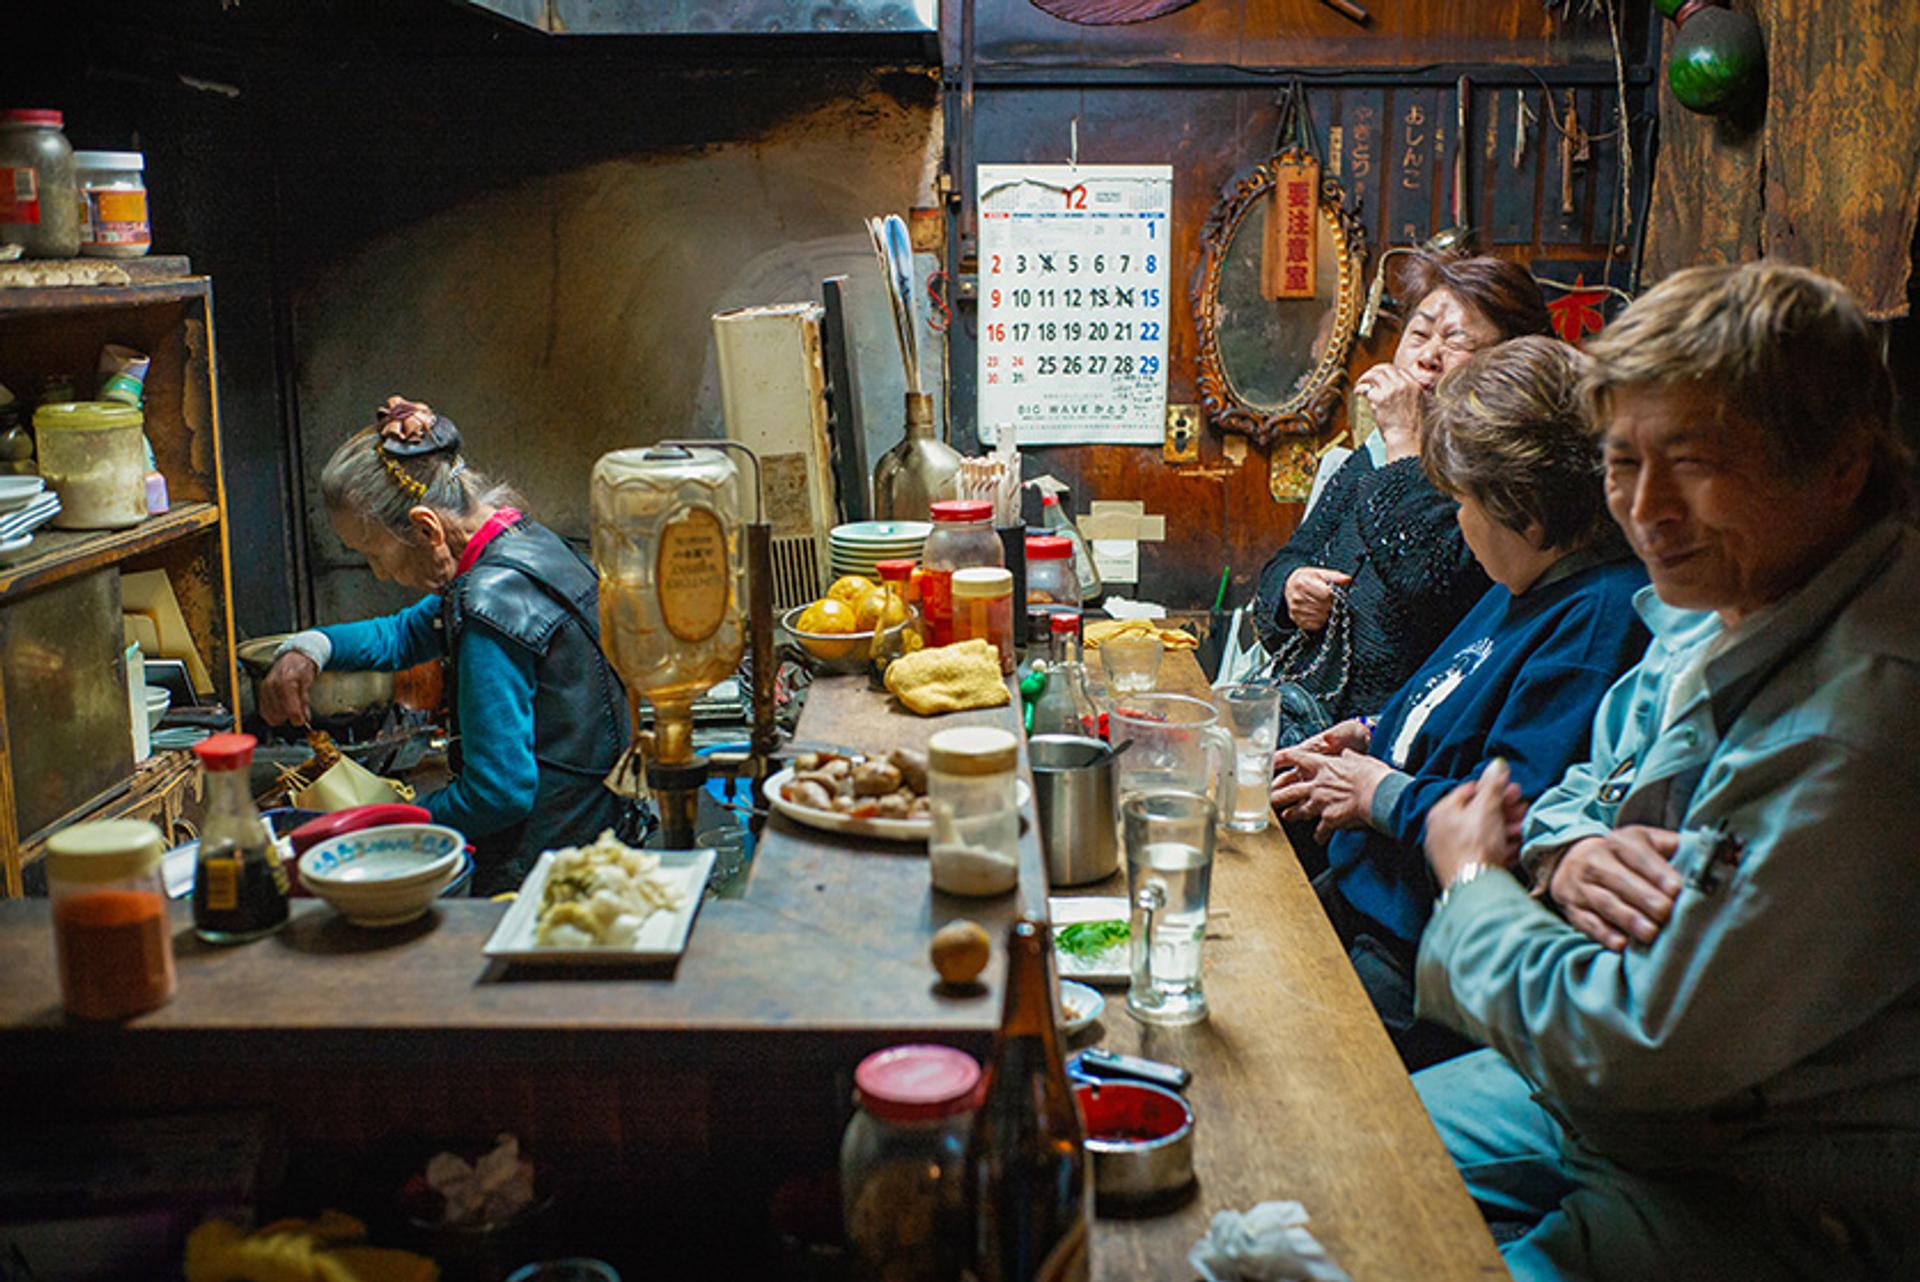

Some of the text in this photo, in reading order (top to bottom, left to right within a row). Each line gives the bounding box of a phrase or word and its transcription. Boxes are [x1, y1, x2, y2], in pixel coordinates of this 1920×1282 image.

[1402, 104, 1425, 189] おしんこ
[1061, 183, 1088, 210] 12
[1146, 220, 1156, 240] 1
[991, 254, 1001, 274] 2
[1016, 254, 1027, 274] 3
[1068, 254, 1079, 274] 5
[1094, 254, 1105, 274] 6
[1120, 254, 1130, 274] 7
[1145, 254, 1157, 274] 8
[991, 289, 1001, 308] 9
[1012, 289, 1032, 308] 10
[1038, 289, 1055, 308] 11
[1063, 289, 1082, 308] 12
[1140, 289, 1161, 308] 15
[987, 322, 1161, 342] 16 17 18 19 20 21 22
[1037, 355, 1160, 375] 25 26 27 28 29
[1017, 404, 1041, 415] BIG
[1049, 404, 1089, 414] WAVE
